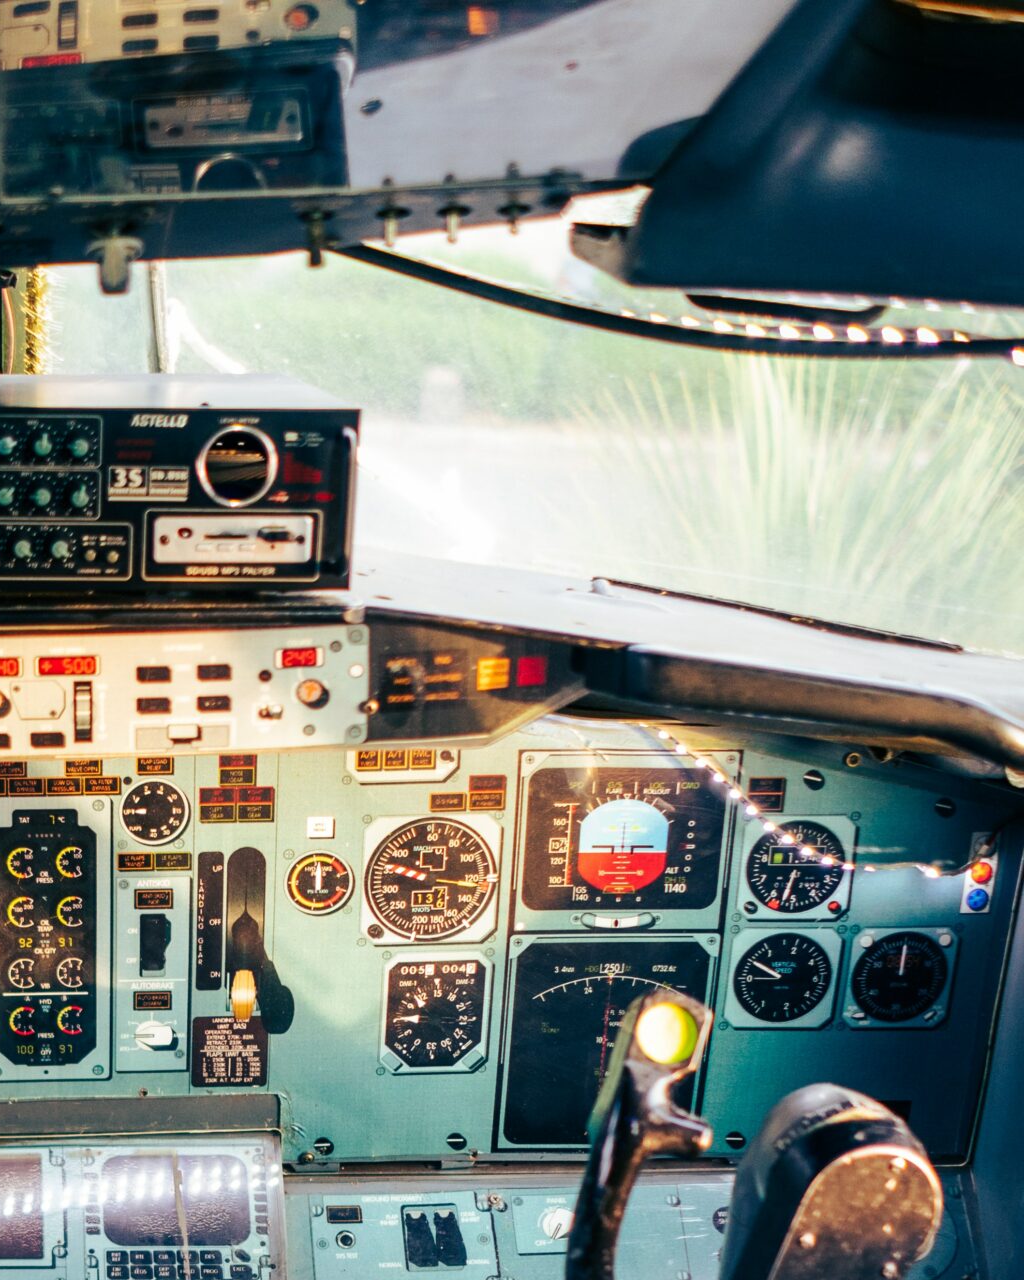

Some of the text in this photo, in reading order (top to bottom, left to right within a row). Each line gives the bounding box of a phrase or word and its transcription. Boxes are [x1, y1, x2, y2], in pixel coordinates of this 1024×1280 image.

[130, 415, 188, 428] ASTELLO
[114, 469, 143, 487] 3S
[221, 567, 240, 575] MP3
[285, 650, 315, 666] 249
[63, 658, 94, 673] 500
[361, 751, 403, 759] A/P A/T
[427, 833, 438, 842] 60
[449, 839, 459, 848] 80
[392, 850, 408, 858] 400
[460, 854, 474, 862] 100
[664, 884, 686, 893] 1140
[444, 909, 458, 917] 160
[19, 938, 32, 947] 92
[605, 964, 619, 972] 250
[17, 1045, 33, 1054] 100
[59, 1045, 72, 1053] 97
